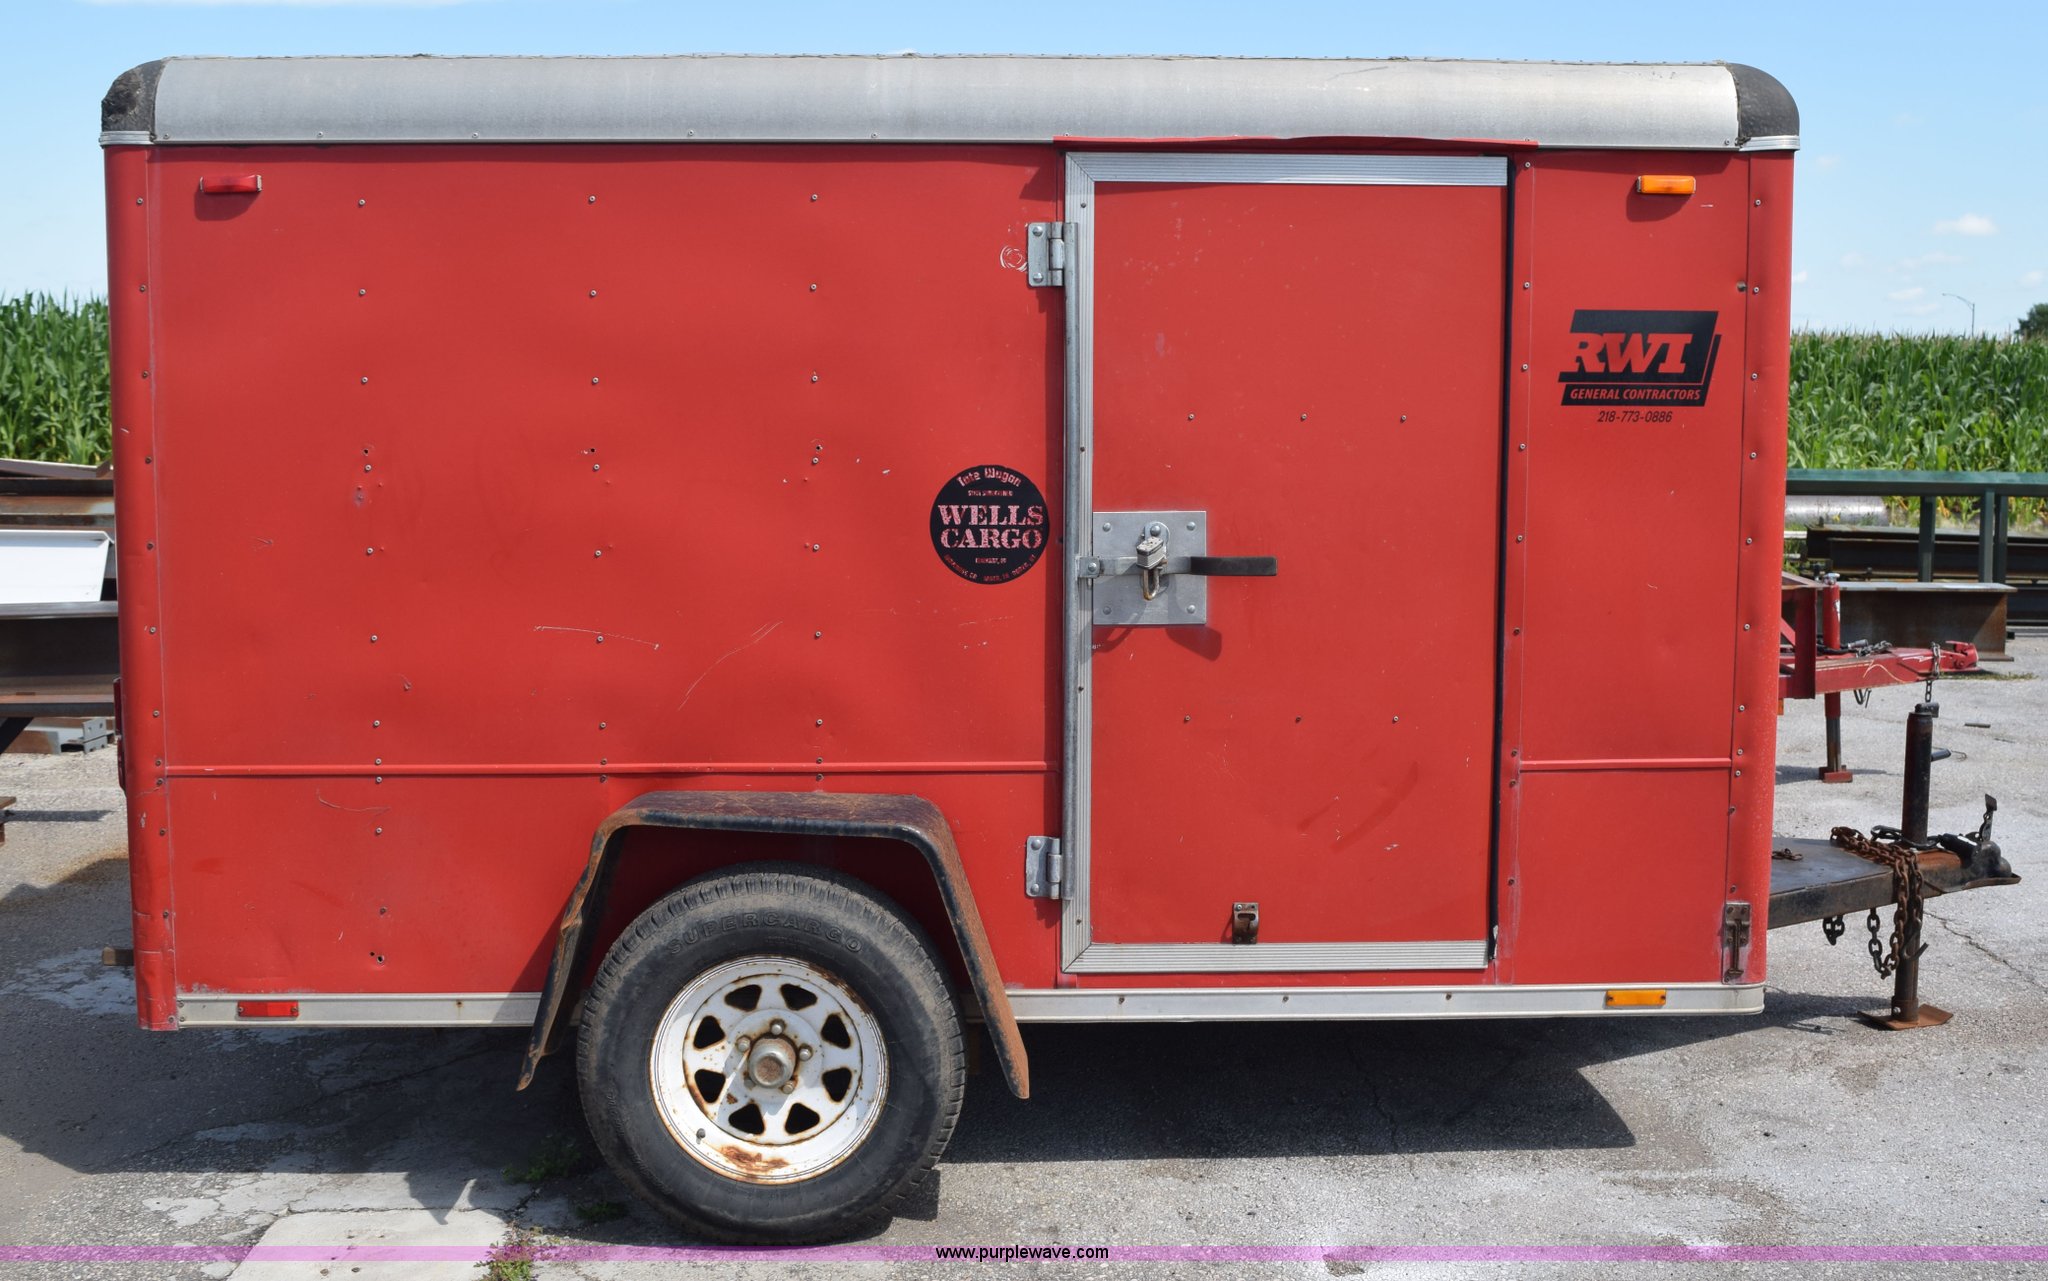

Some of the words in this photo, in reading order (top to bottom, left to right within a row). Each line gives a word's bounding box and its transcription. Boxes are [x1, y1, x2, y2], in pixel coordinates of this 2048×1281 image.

[1572, 332, 1693, 374] RWI
[1570, 388, 1620, 400] GENERAL
[1623, 388, 1701, 400] CONTRACTORS
[1597, 410, 1673, 423] 218-773-0886
[937, 504, 1044, 526] WELLS
[940, 528, 1042, 549] CARGO
[667, 911, 863, 954] SUPERCARGO
